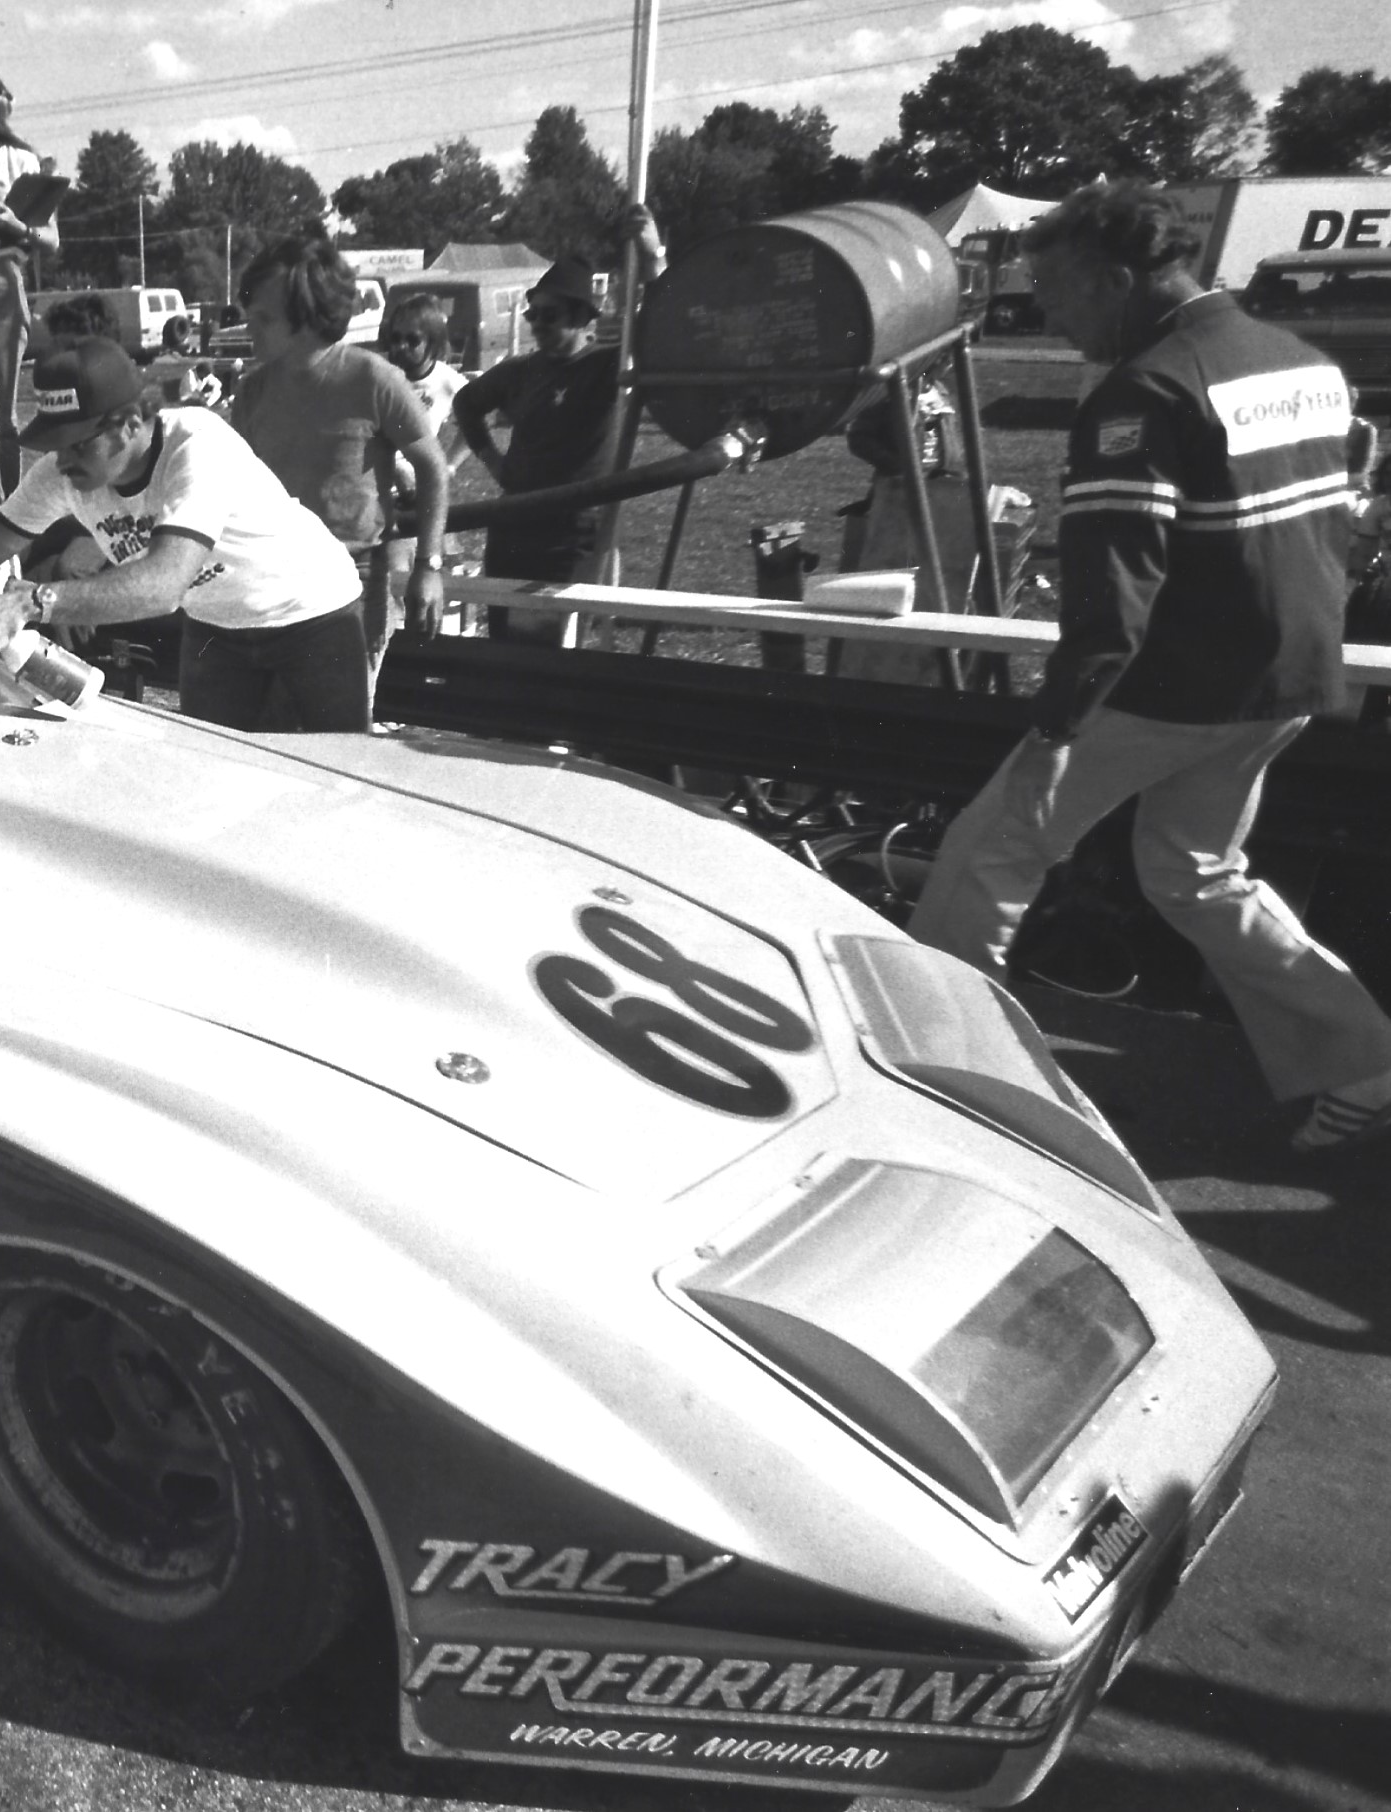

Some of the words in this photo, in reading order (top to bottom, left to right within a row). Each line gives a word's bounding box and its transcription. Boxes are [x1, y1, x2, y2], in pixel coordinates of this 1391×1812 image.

[1298, 209, 1391, 251] DE
[370, 254, 413, 265] CAMEL
[526, 902, 817, 1124] 68
[411, 1539, 734, 1606] TRACY
[694, 1736, 889, 1770] MICHIGAN
